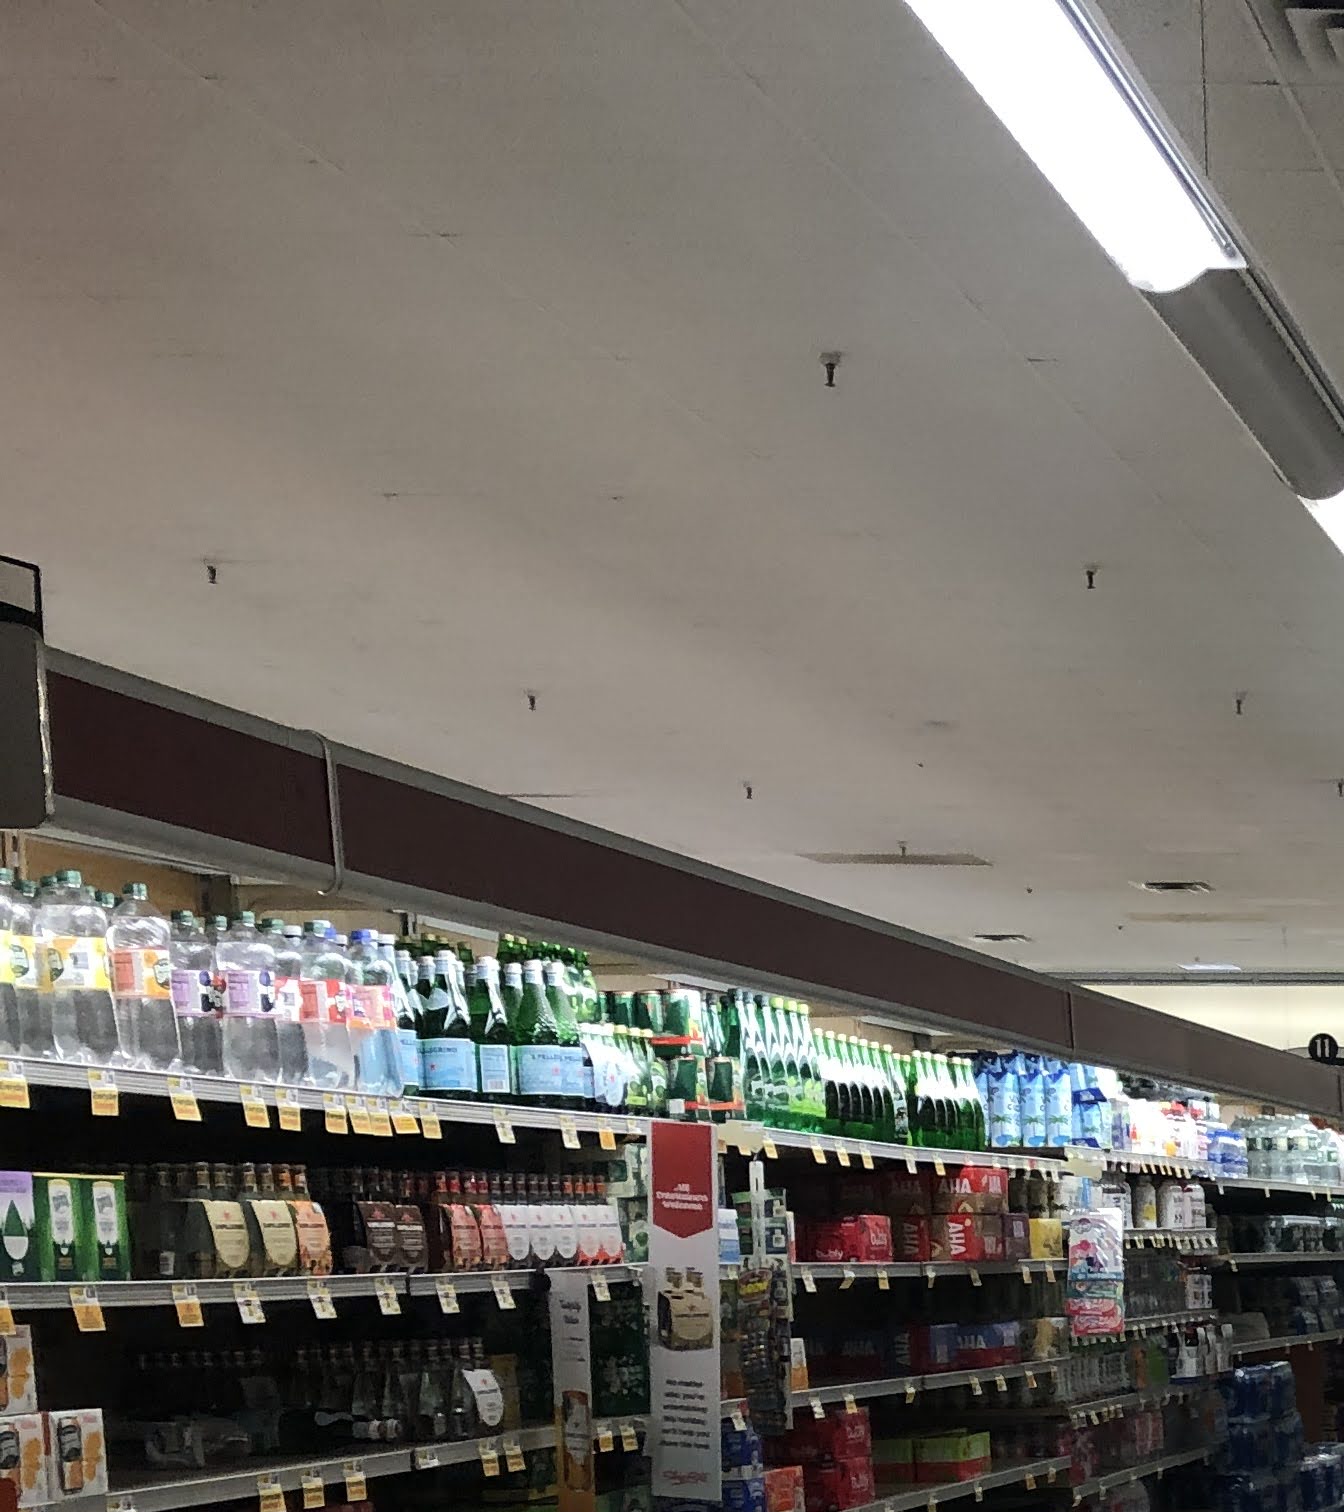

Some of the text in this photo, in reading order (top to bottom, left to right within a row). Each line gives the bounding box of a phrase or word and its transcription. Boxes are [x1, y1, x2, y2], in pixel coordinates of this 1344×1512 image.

[1315, 1039, 1329, 1058] 11
[938, 1177, 971, 1194] AHA
[949, 1221, 966, 1255] AHA
